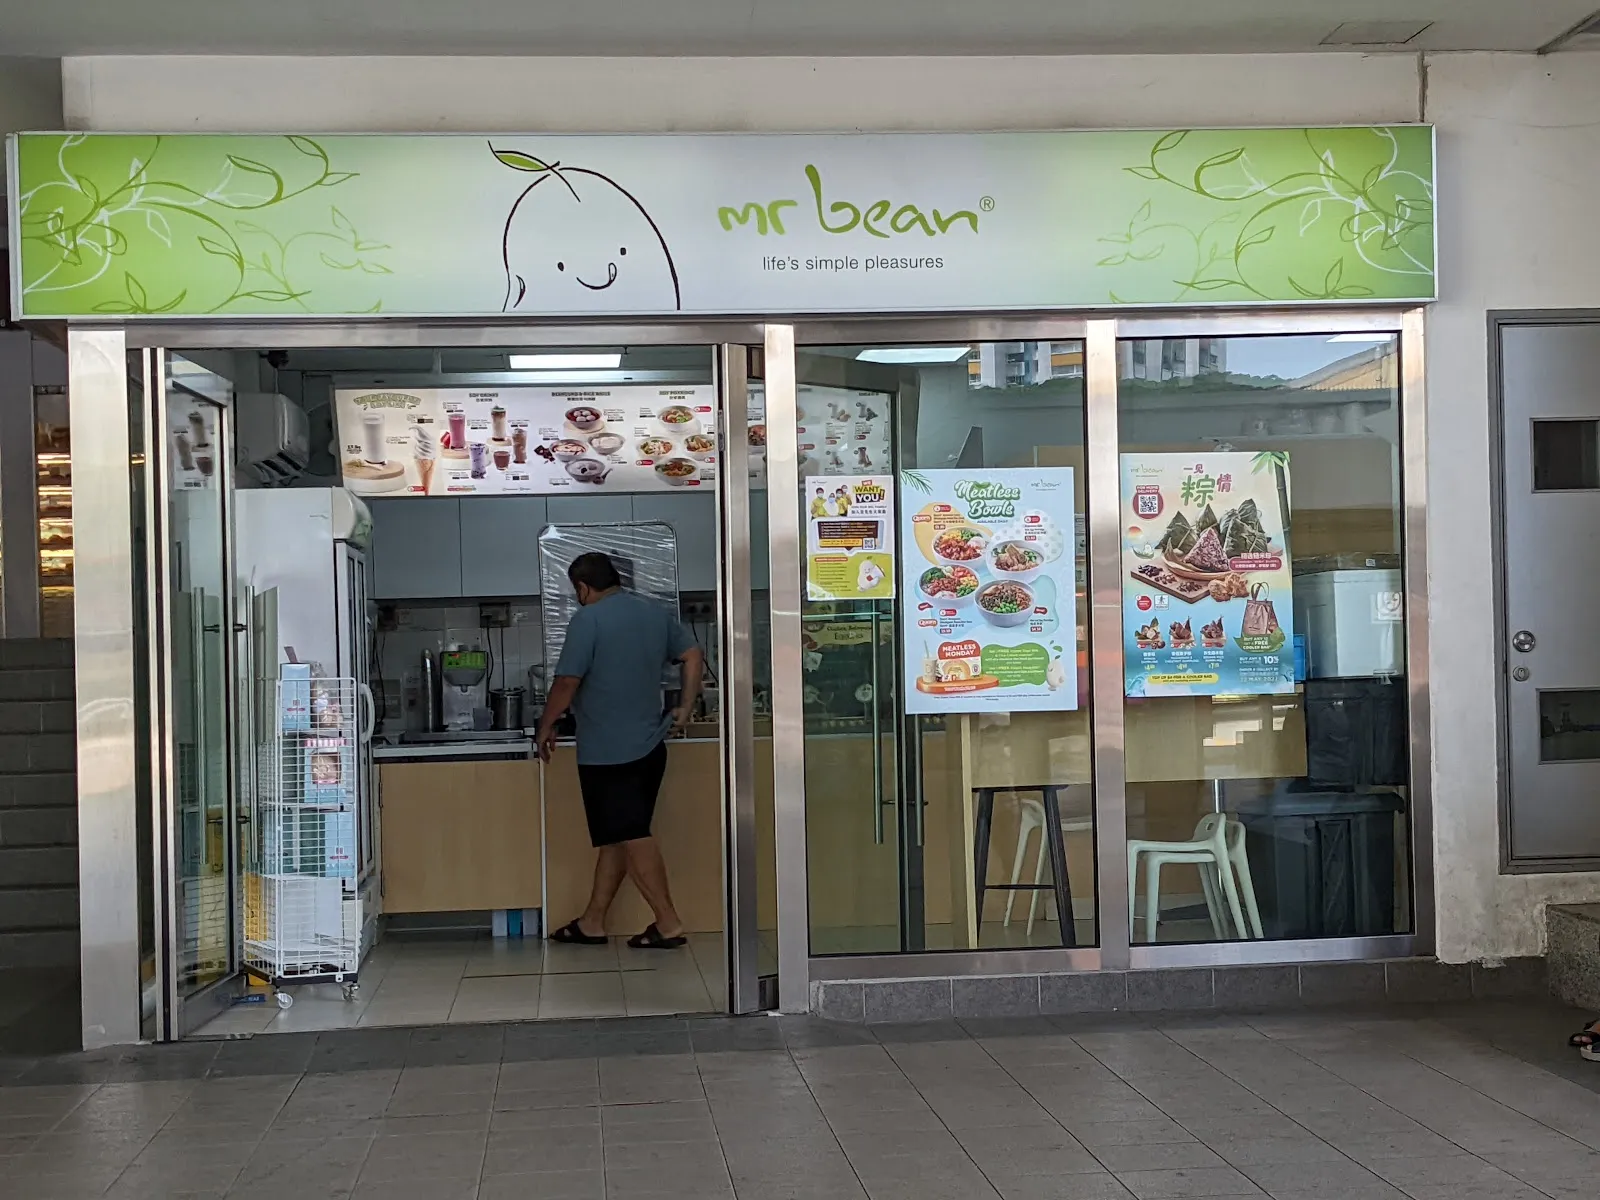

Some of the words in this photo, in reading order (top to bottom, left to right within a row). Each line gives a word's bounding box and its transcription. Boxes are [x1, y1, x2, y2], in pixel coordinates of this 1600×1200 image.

[718, 199, 797, 236] mr
[804, 164, 978, 238] bean
[762, 255, 799, 271] life's
[805, 255, 859, 272] simple
[865, 255, 944, 271] pleasures
[955, 480, 1020, 500] Meatless
[1181, 474, 1216, 508] 粽
[1217, 473, 1232, 492] 情
[968, 500, 1014, 518] Bowls
[942, 644, 976, 652] MEATLESS
[1263, 655, 1279, 664] 10%
